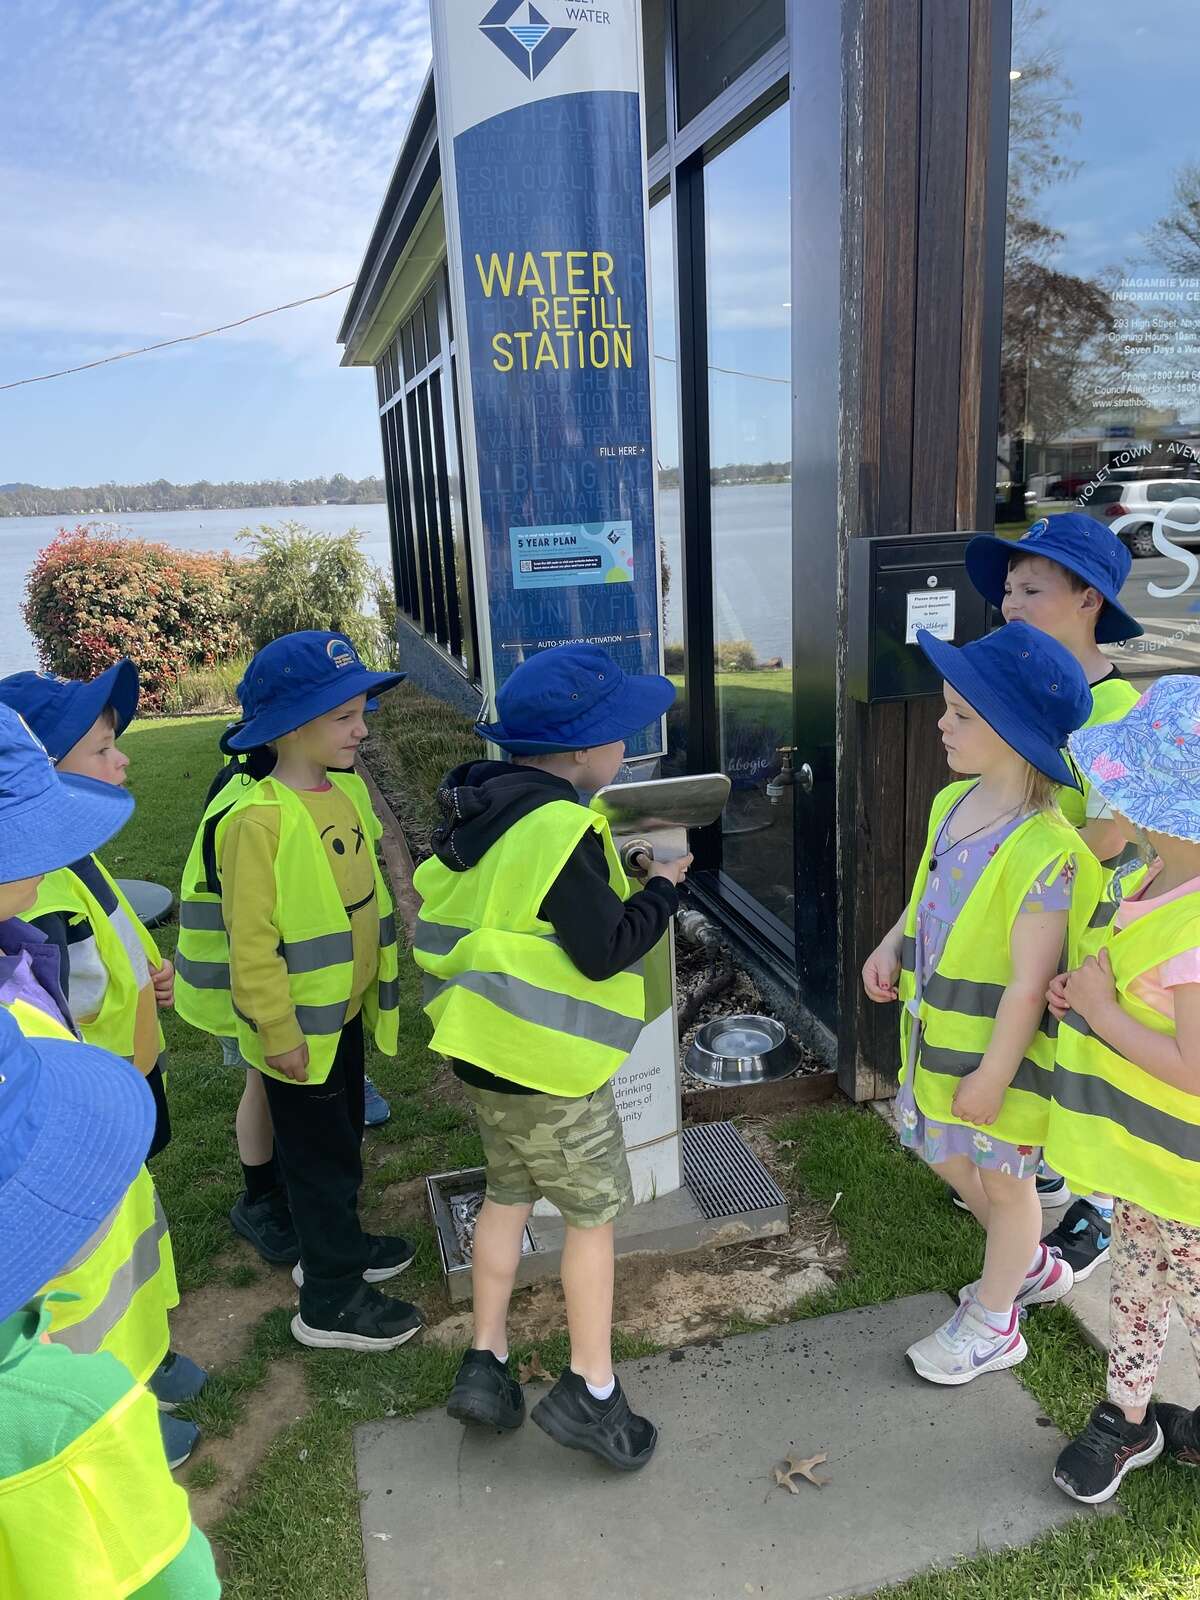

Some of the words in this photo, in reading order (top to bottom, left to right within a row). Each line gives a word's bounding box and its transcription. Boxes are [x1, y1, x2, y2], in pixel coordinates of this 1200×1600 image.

[565, 7, 611, 25] WATER
[474, 250, 616, 299] WATER
[1120, 278, 1177, 288] NAGAMBIE
[1111, 291, 1183, 301] INFORMATION
[531, 296, 632, 331] REFILL
[1113, 319, 1129, 329] 293
[1131, 319, 1150, 330] High
[1107, 332, 1144, 343] Opening
[491, 330, 633, 371] STATION
[1124, 345, 1151, 355] Seven
[1153, 344, 1175, 356] Days
[1094, 384, 1126, 395] Council
[599, 447, 616, 457] FILL
[617, 446, 638, 456] HERE
[1075, 463, 1112, 509] VIOLET
[1112, 444, 1152, 468] TOWN
[518, 539, 524, 548] 5
[526, 537, 550, 548] YEAR
[553, 535, 577, 546] PLAN
[585, 634, 623, 645] ACTIVATION
[618, 1076, 628, 1086] to
[629, 1065, 661, 1084] provide
[614, 1081, 652, 1099] drinking
[643, 1092, 652, 1104] of
